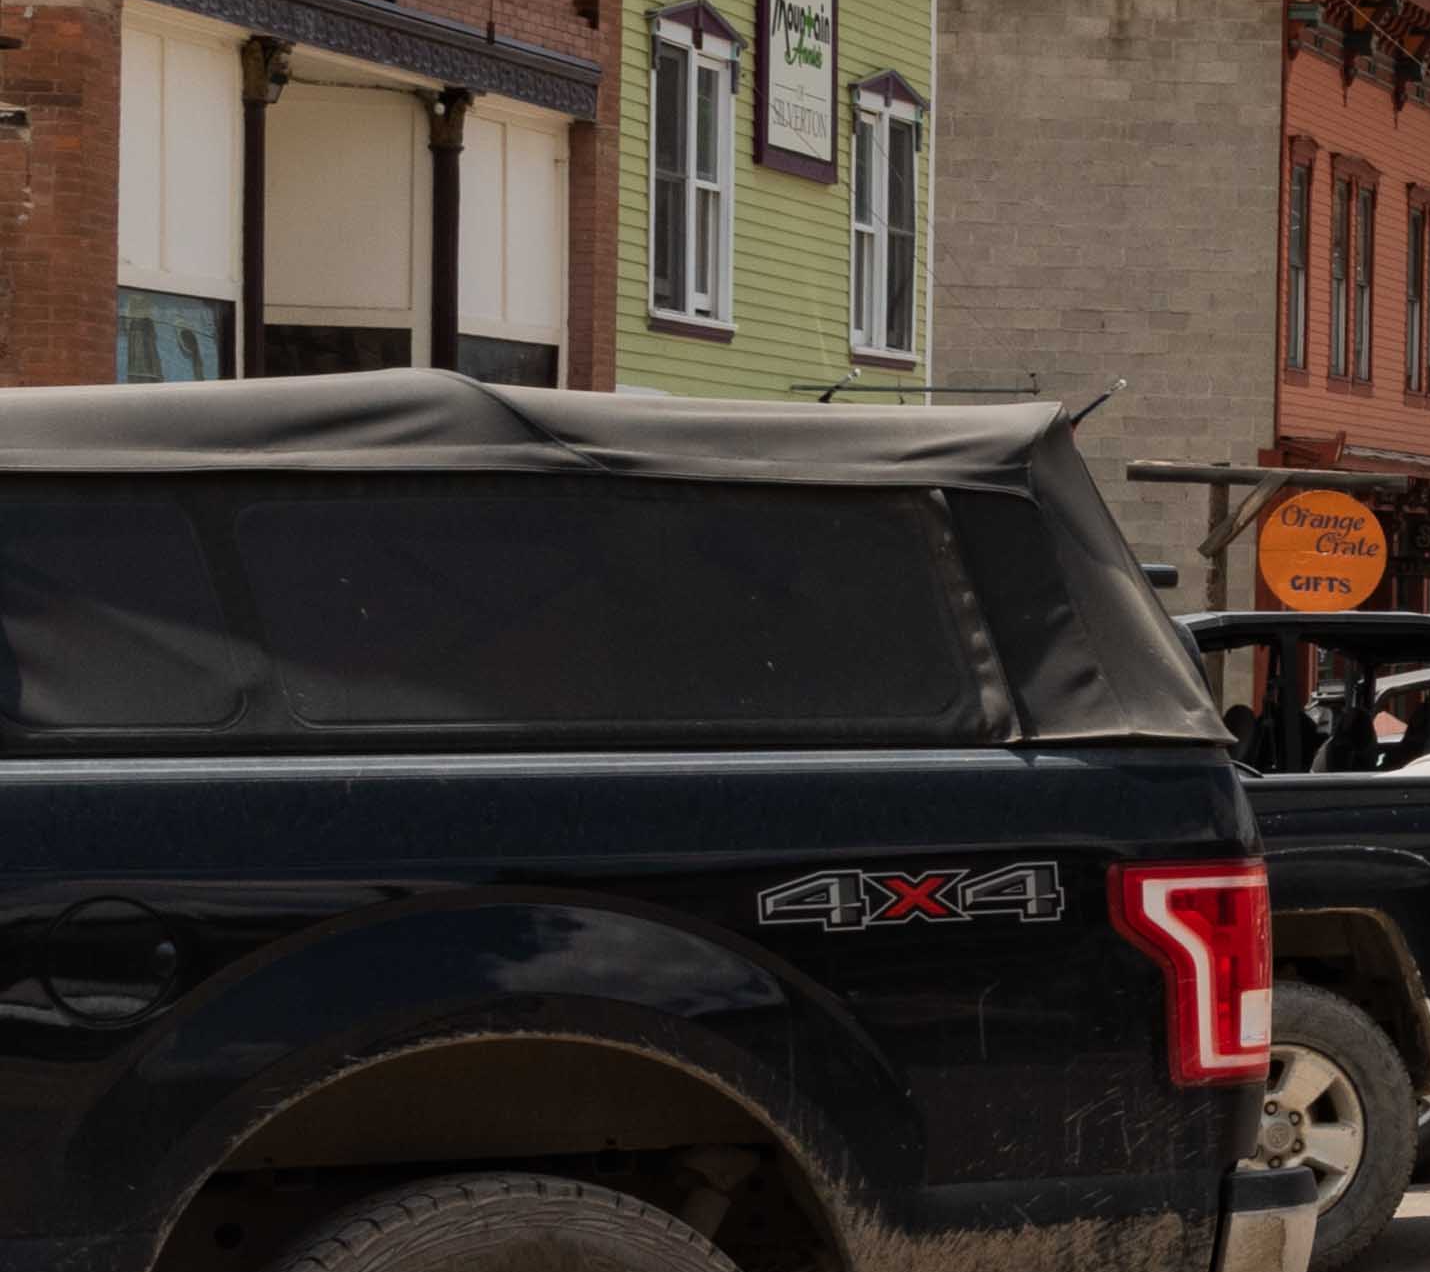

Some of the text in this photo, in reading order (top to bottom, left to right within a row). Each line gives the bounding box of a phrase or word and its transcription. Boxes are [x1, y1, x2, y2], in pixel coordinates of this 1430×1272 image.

[772, 98, 827, 139] SILVERTON
[1281, 504, 1365, 538] Orange
[1315, 531, 1380, 557] Crate
[1289, 575, 1352, 595] GIFTS
[758, 862, 1064, 931] 4X4
